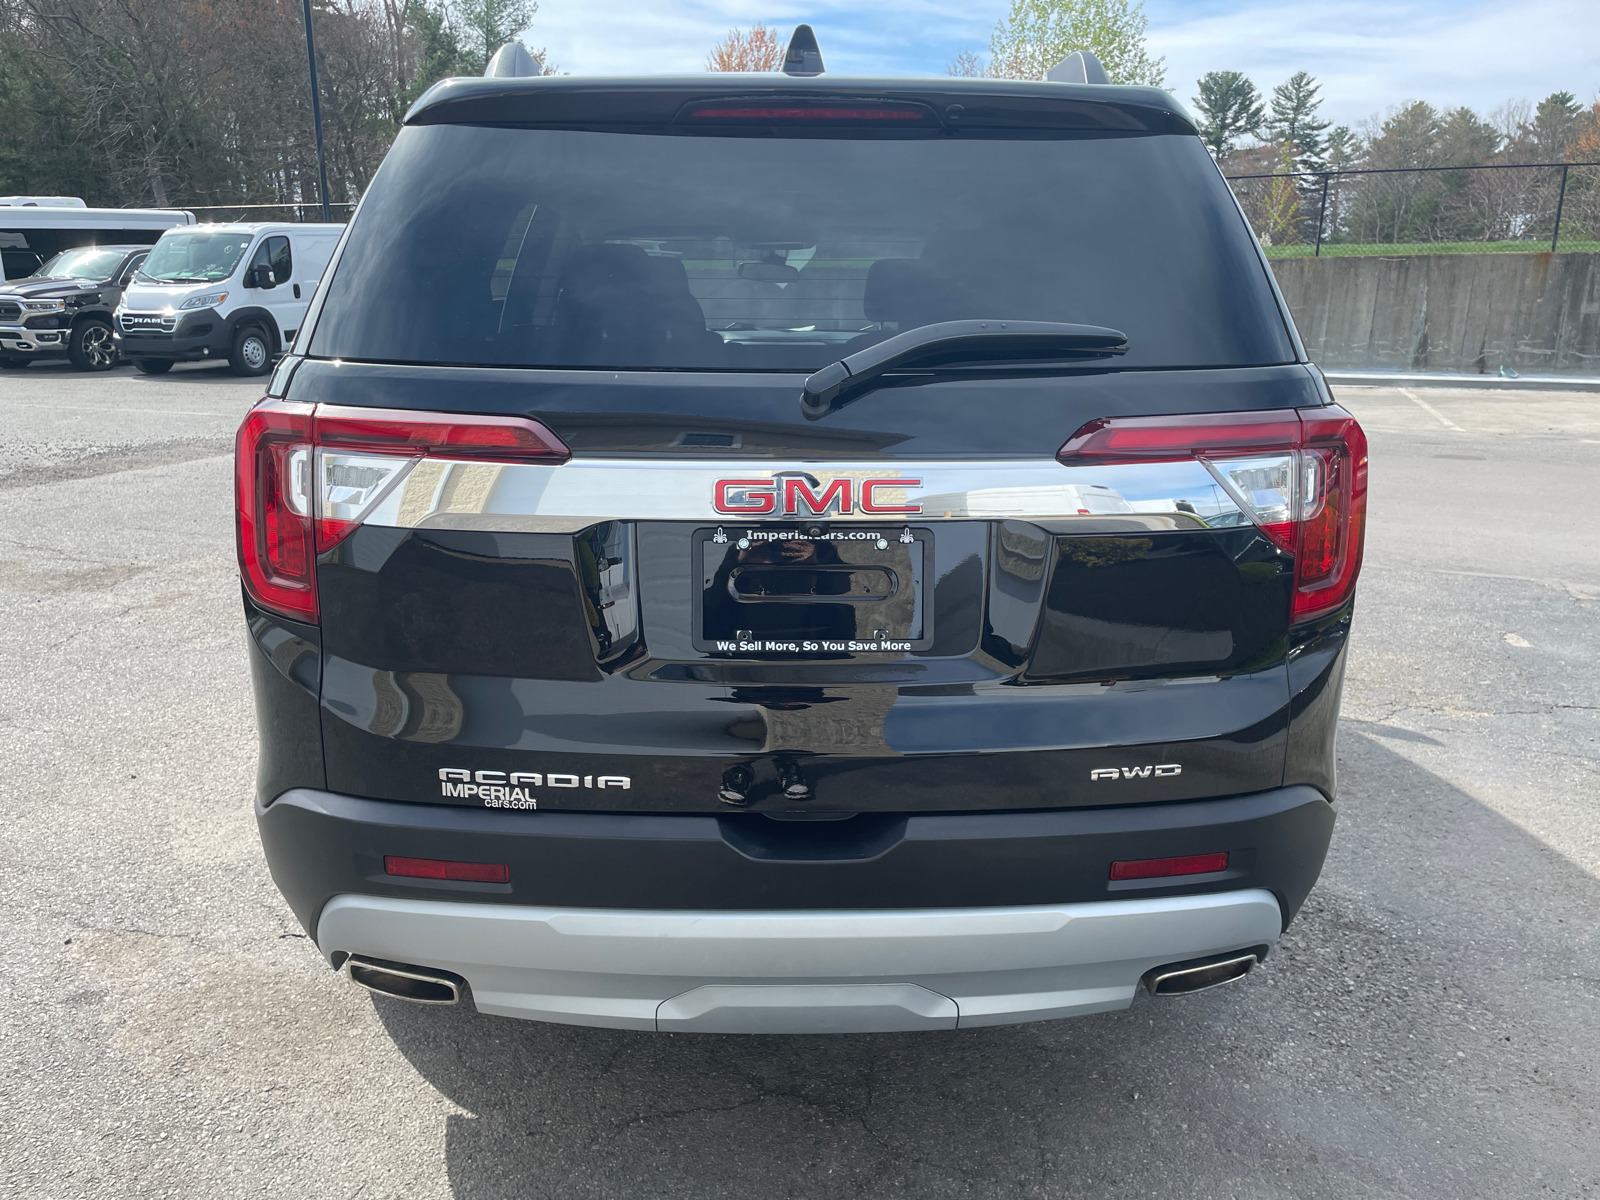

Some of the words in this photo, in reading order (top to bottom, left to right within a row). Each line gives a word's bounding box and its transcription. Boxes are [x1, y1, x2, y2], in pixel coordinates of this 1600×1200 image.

[712, 476, 923, 516] GMC
[746, 530, 881, 542] Imperiaars.com
[717, 641, 736, 651] We
[739, 641, 762, 651] Sell
[765, 641, 800, 653] More,
[802, 641, 818, 651] So
[822, 641, 845, 651] You
[848, 641, 878, 651] Save
[881, 640, 911, 651] More
[438, 767, 631, 790] ACADIA
[1090, 763, 1182, 781] AWD
[441, 781, 537, 803] IMPERIAL
[484, 798, 537, 810] cars.com
